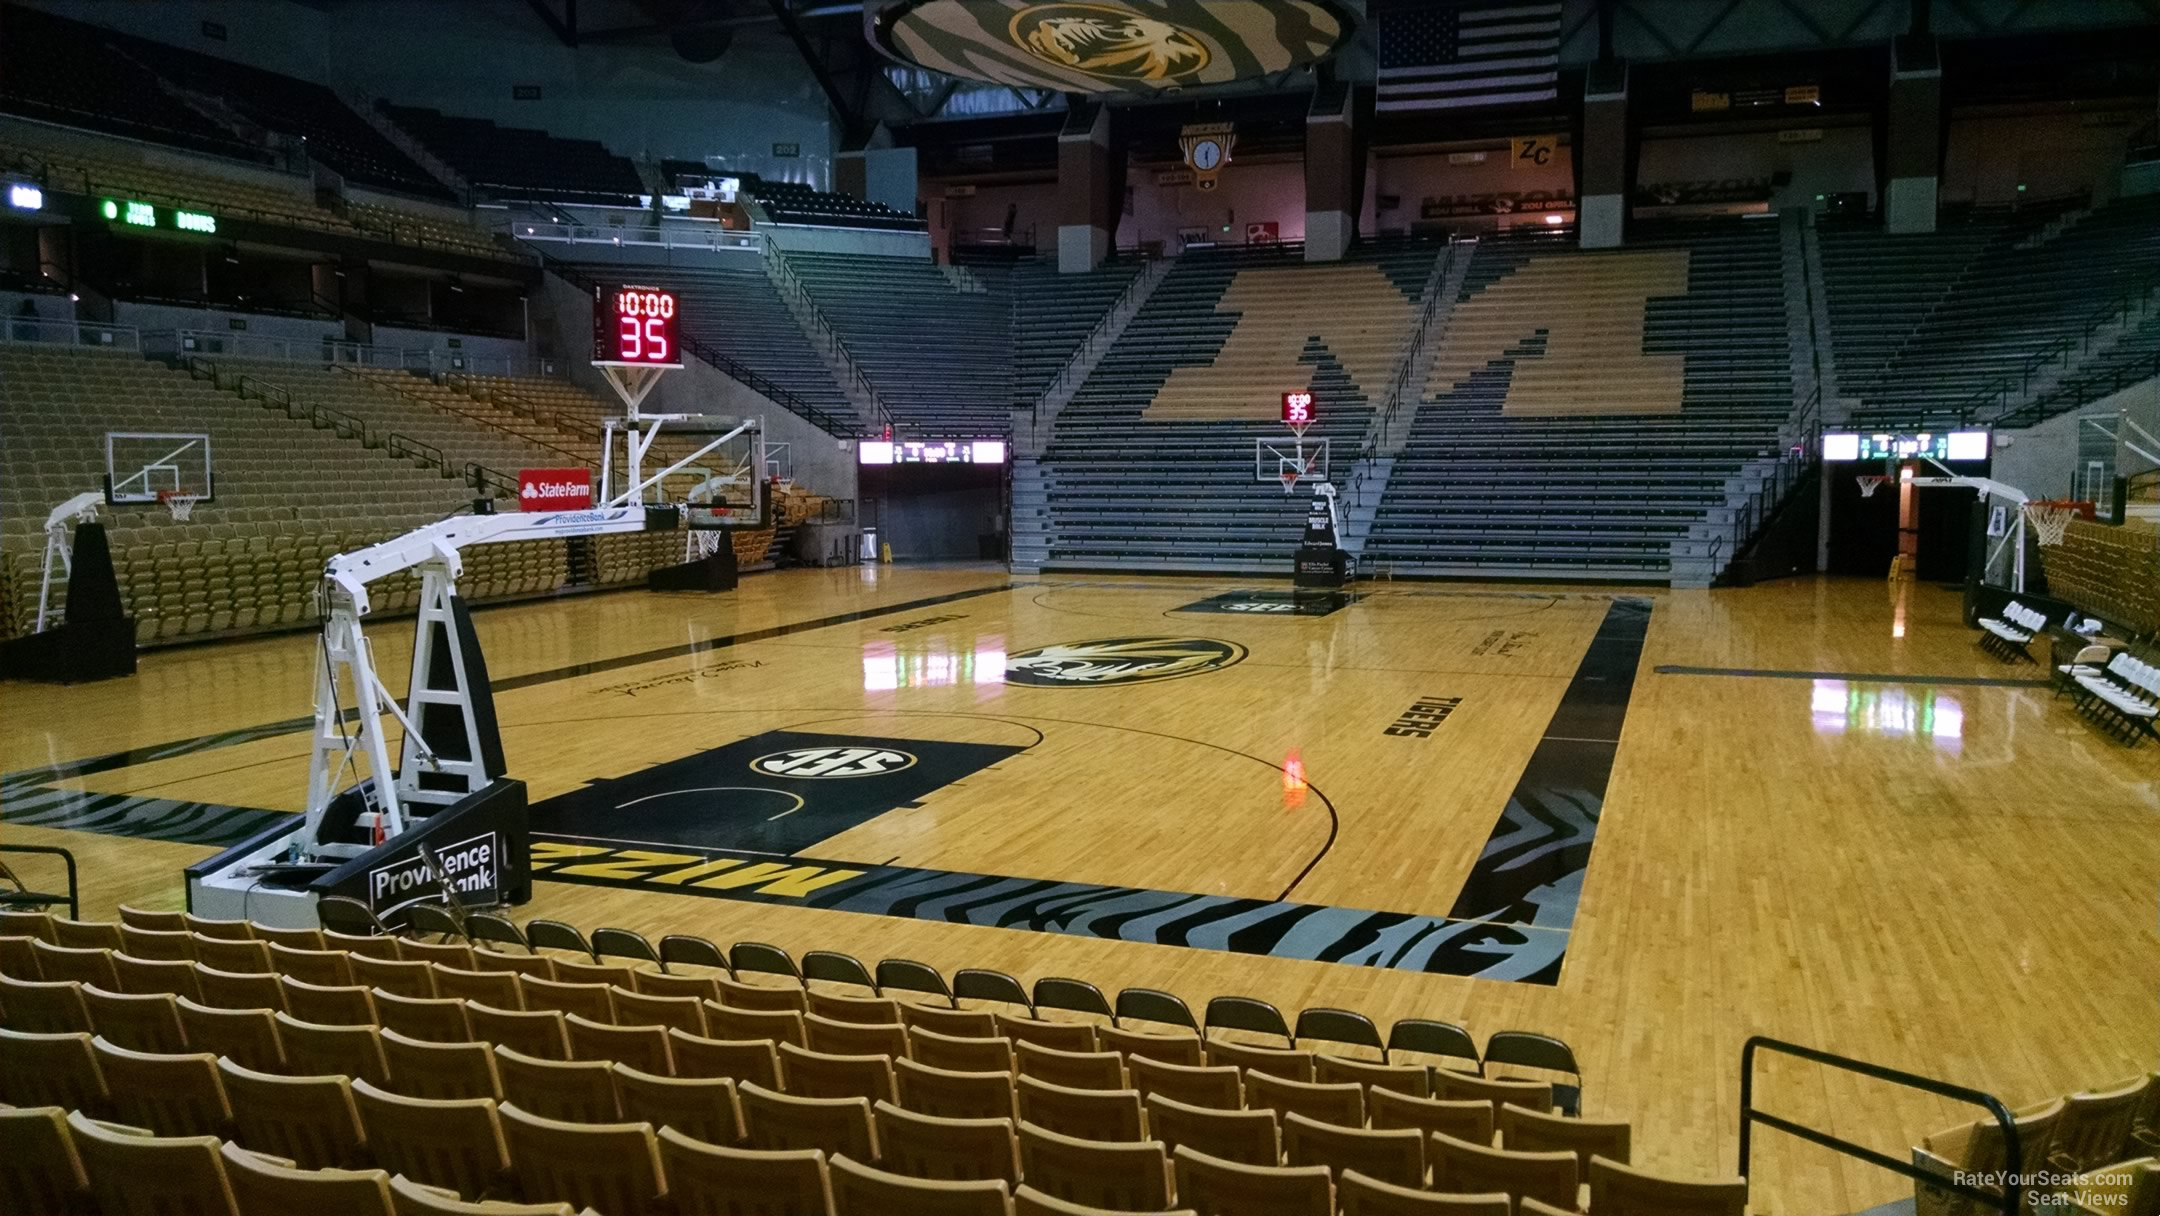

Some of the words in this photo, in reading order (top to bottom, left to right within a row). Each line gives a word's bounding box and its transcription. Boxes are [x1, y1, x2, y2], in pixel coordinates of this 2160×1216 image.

[177, 211, 216, 233] BONUS
[619, 291, 674, 319] 10:00
[621, 316, 667, 359] 35
[1289, 406, 1308, 420] 35
[1308, 516, 1329, 525] MUSCLE
[1382, 695, 1464, 739] TIGERS
[529, 841, 869, 898] MIZZ
